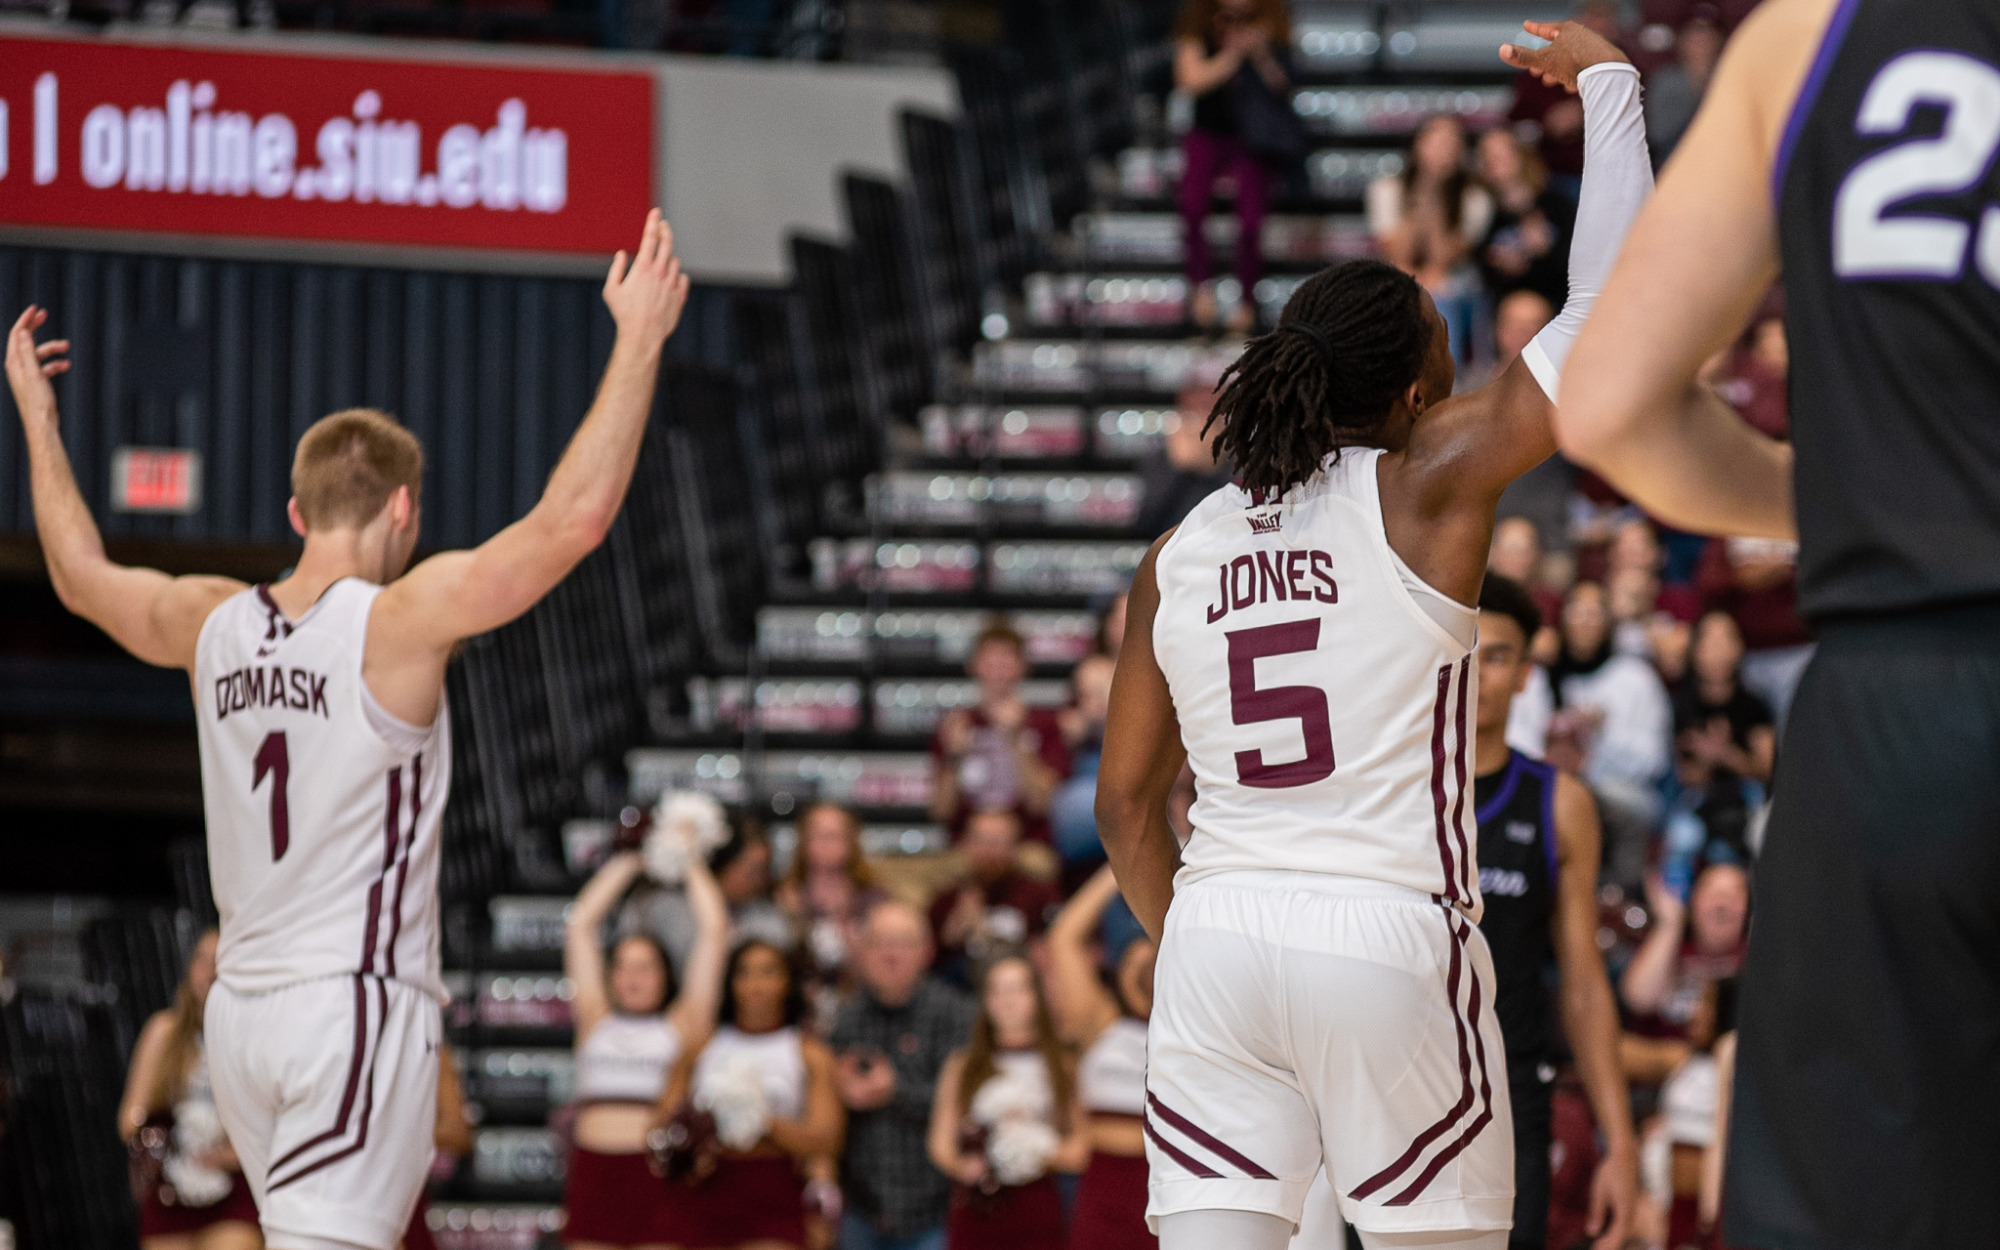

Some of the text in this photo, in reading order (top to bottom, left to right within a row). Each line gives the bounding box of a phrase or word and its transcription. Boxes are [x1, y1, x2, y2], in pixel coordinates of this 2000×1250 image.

[81, 78, 567, 213] online.siu.edu
[1831, 47, 2000, 293] 2
[1207, 550, 1338, 624] JONES
[1246, 510, 1282, 531] VALLEY
[215, 665, 329, 721] DOMASK
[1223, 617, 1336, 789] 5
[251, 729, 290, 863] 1
